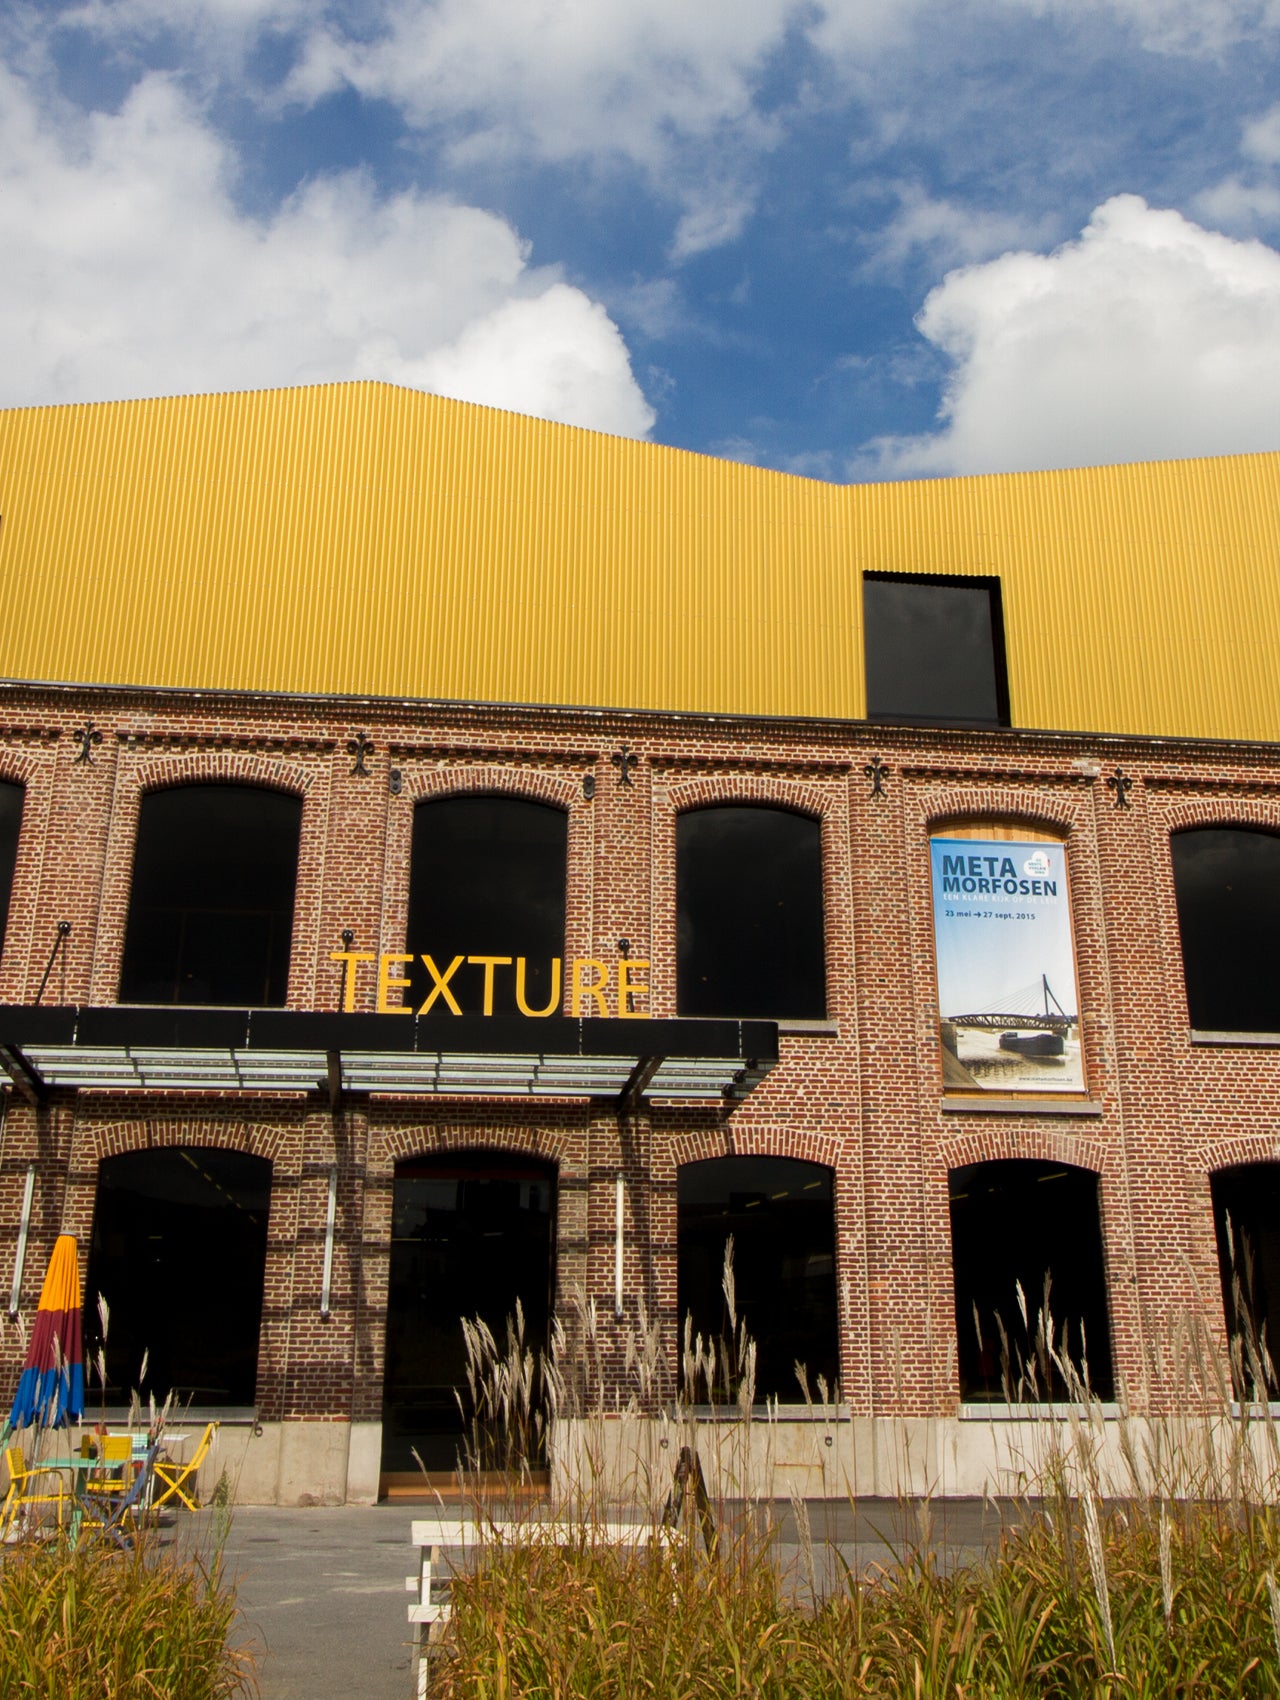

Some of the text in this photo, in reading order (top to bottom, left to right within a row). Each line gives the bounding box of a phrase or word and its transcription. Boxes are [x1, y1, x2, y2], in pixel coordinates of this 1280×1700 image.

[942, 855, 1017, 878] META
[943, 877, 1057, 896] MORFOSEN
[995, 912, 1015, 920] sept.
[1016, 912, 1036, 920] 2015
[330, 952, 651, 1019] TEXTURE
